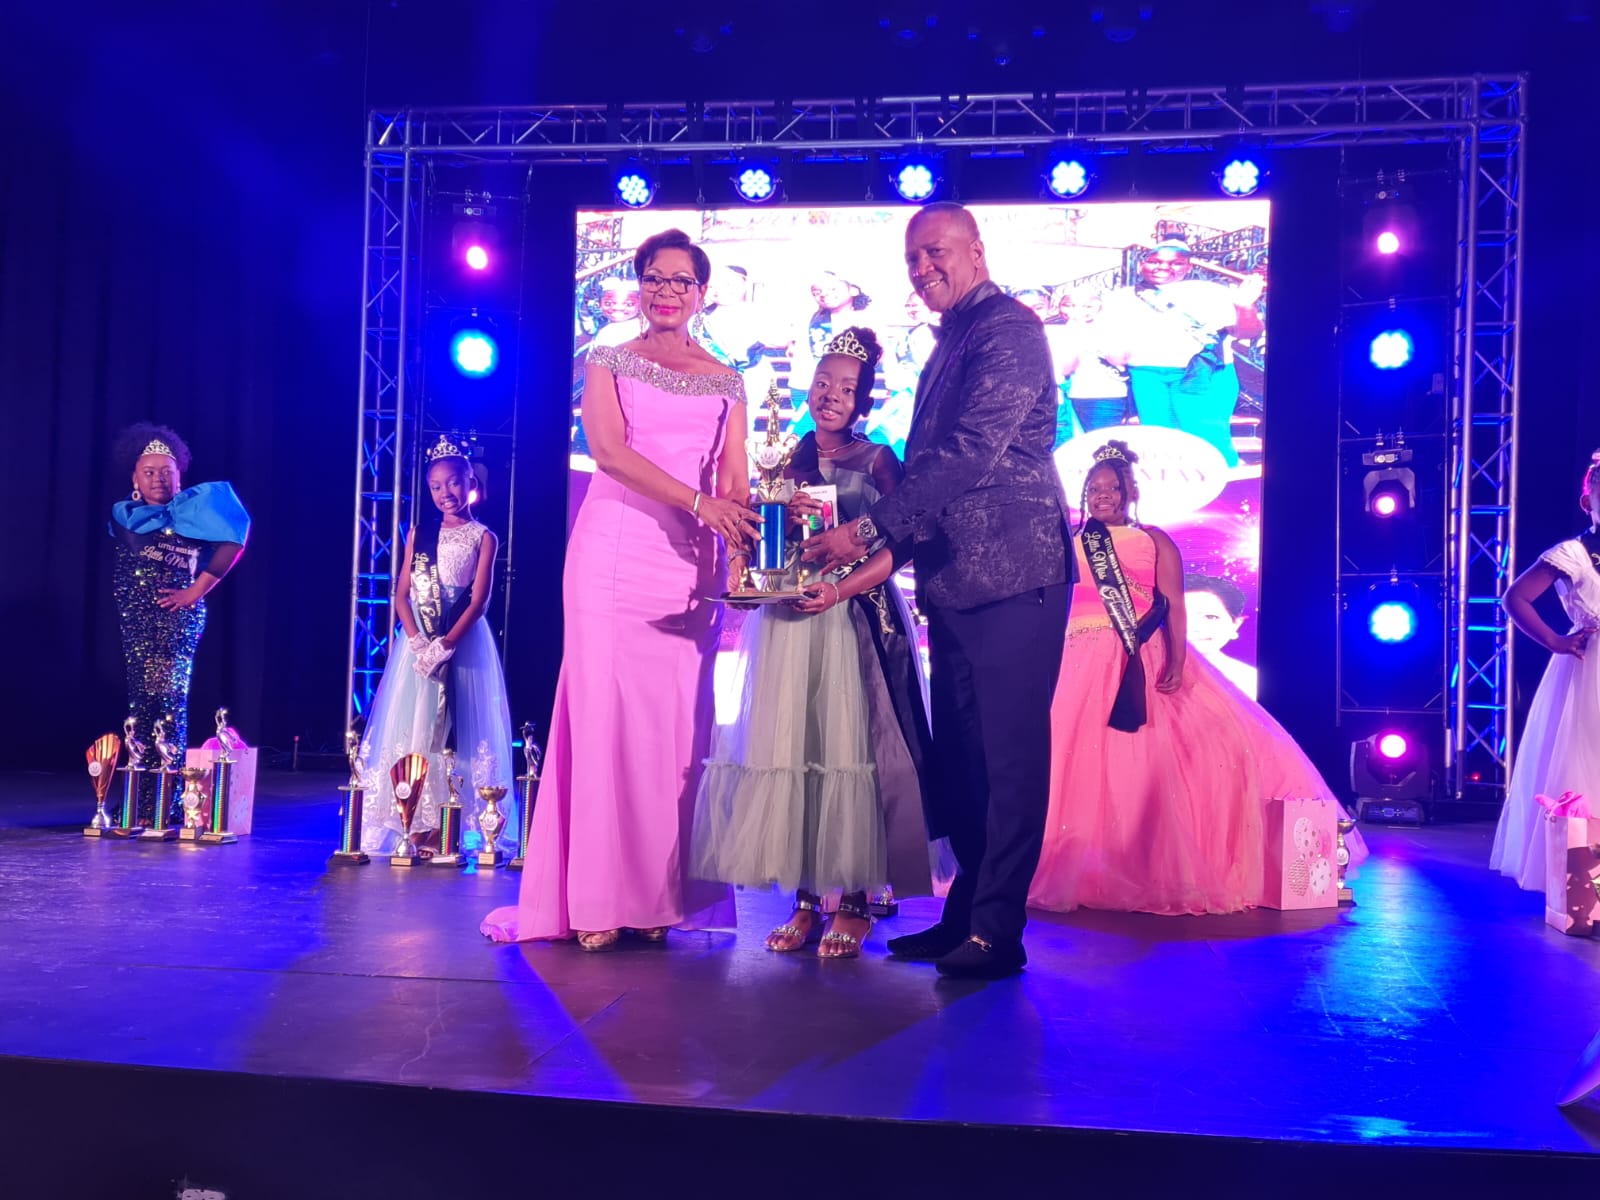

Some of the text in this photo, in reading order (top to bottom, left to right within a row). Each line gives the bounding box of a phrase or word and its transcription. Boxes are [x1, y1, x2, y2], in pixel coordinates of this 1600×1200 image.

[158, 542, 175, 551] LITTLE
[1084, 531, 1101, 552] Little
[1104, 537, 1113, 554] LITTLE
[1109, 554, 1119, 569] MISS
[140, 545, 163, 561] Little
[164, 552, 188, 568] Miss
[1092, 552, 1108, 580] Miss
